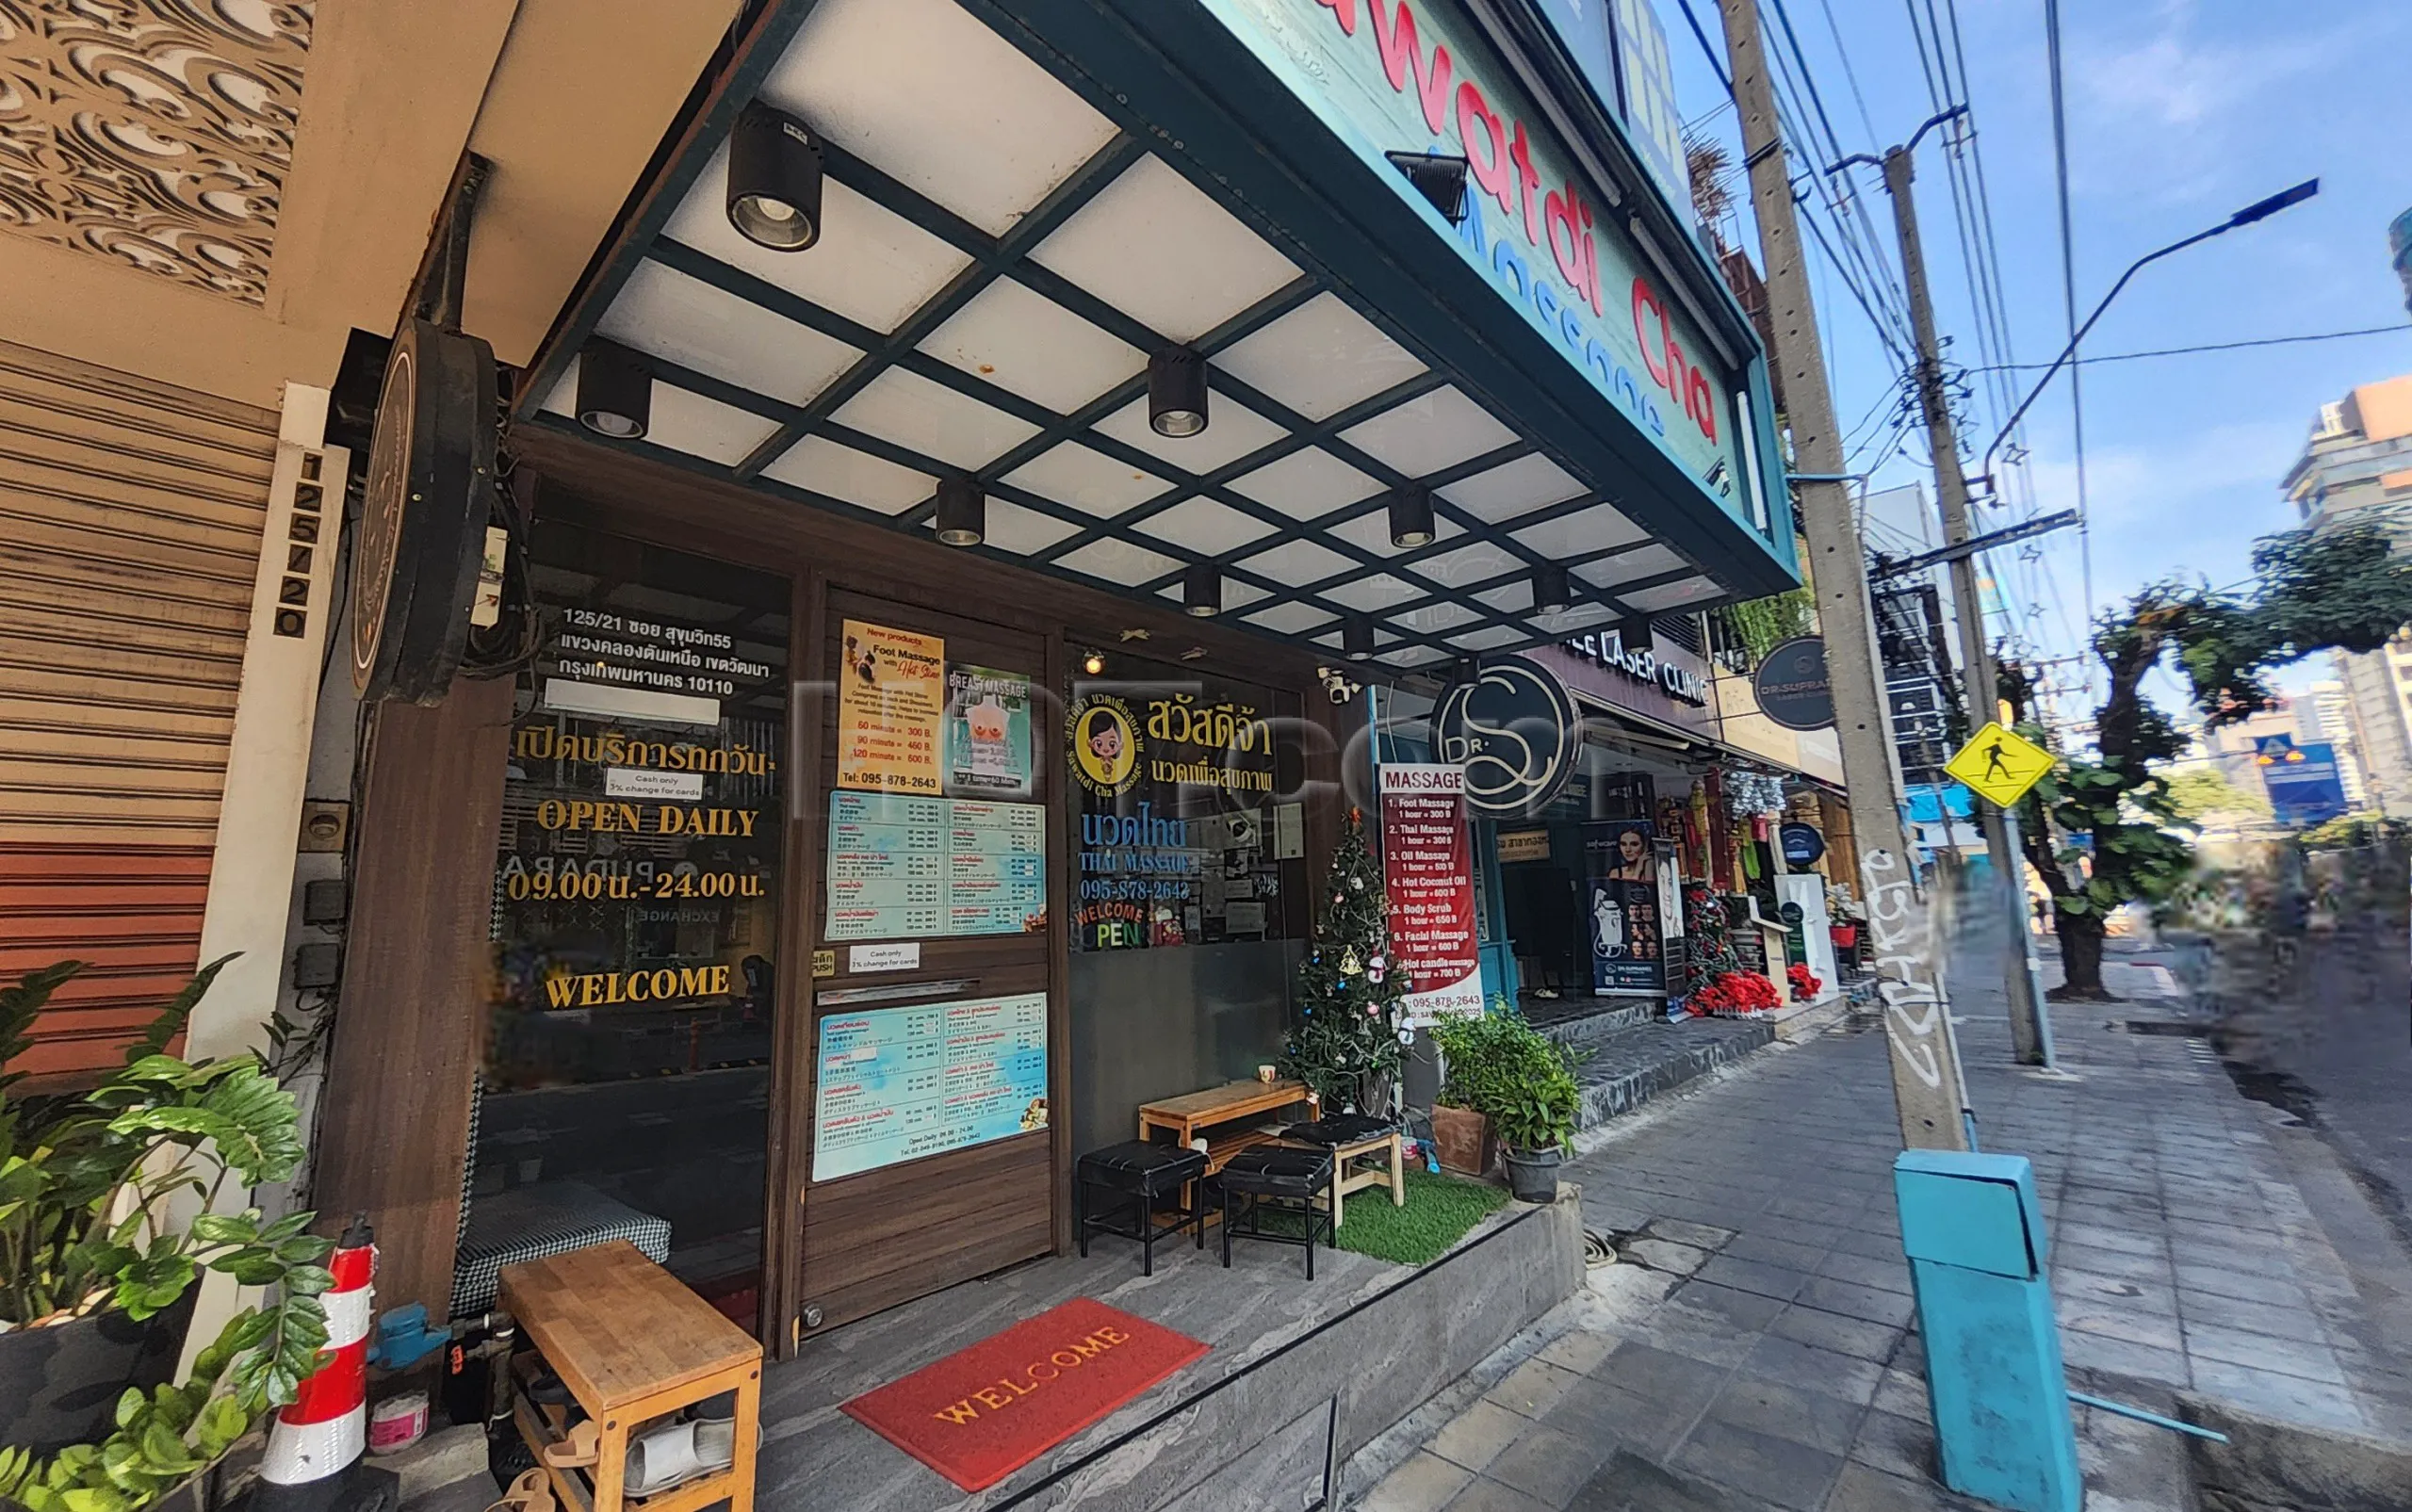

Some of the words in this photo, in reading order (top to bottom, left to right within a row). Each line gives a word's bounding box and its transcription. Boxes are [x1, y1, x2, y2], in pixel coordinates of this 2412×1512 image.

[1314, 0, 1603, 317] watdi
[1632, 276, 1717, 447] Cha
[563, 608, 622, 632] 125/21
[628, 620, 660, 638] ซอย
[665, 626, 731, 650] สุขุมวิท55
[867, 627, 885, 638] New
[561, 634, 701, 668] แขวงคลองตันเหนือ
[706, 654, 770, 678] เขตวัฒนา
[872, 644, 896, 657] Foot
[898, 648, 940, 666] Massage
[559, 658, 683, 689] กรุงเทพมหานคร
[688, 676, 733, 695] 10110
[985, 679, 1027, 698] MASSAGE
[907, 726, 922, 737] 300
[1148, 692, 1273, 756] สวัสดีจ้า
[853, 747, 868, 758] 120
[635, 775, 658, 784] Cash
[660, 777, 679, 786] only
[843, 772, 859, 783] Tel:
[861, 772, 937, 789] 095-878-2643
[1151, 756, 1273, 795] นวดเพื่อสุขภาพ
[1385, 772, 1462, 789] MASSAGE
[676, 788, 700, 796] cards
[1399, 799, 1417, 807] Foot
[1419, 799, 1455, 809] Massage
[537, 799, 641, 834] OPEN
[659, 805, 759, 837] DAILY
[1430, 810, 1443, 819] 300
[1081, 801, 1187, 848] นวดไทย
[1389, 825, 1398, 834] 2.
[1400, 824, 1418, 834] Thai
[1420, 825, 1454, 836] Massage
[1078, 852, 1117, 871] THAI
[1390, 852, 1399, 860] 3.
[1401, 852, 1413, 860] Oil
[1415, 851, 1450, 861] Massage
[1080, 878, 1190, 901] 095-878-2643
[1392, 878, 1400, 886] 4.
[1402, 877, 1417, 886] Hot
[1454, 875, 1467, 886] Oil
[1075, 902, 1145, 926] WELCOME
[1393, 905, 1401, 914] 5.
[1404, 904, 1426, 915] Body
[1427, 903, 1452, 914] Scrub
[1431, 931, 1469, 941] Massage
[863, 959, 888, 967] change
[546, 964, 730, 1009] WELCOME
[933, 1325, 1132, 1426] WELCOME
